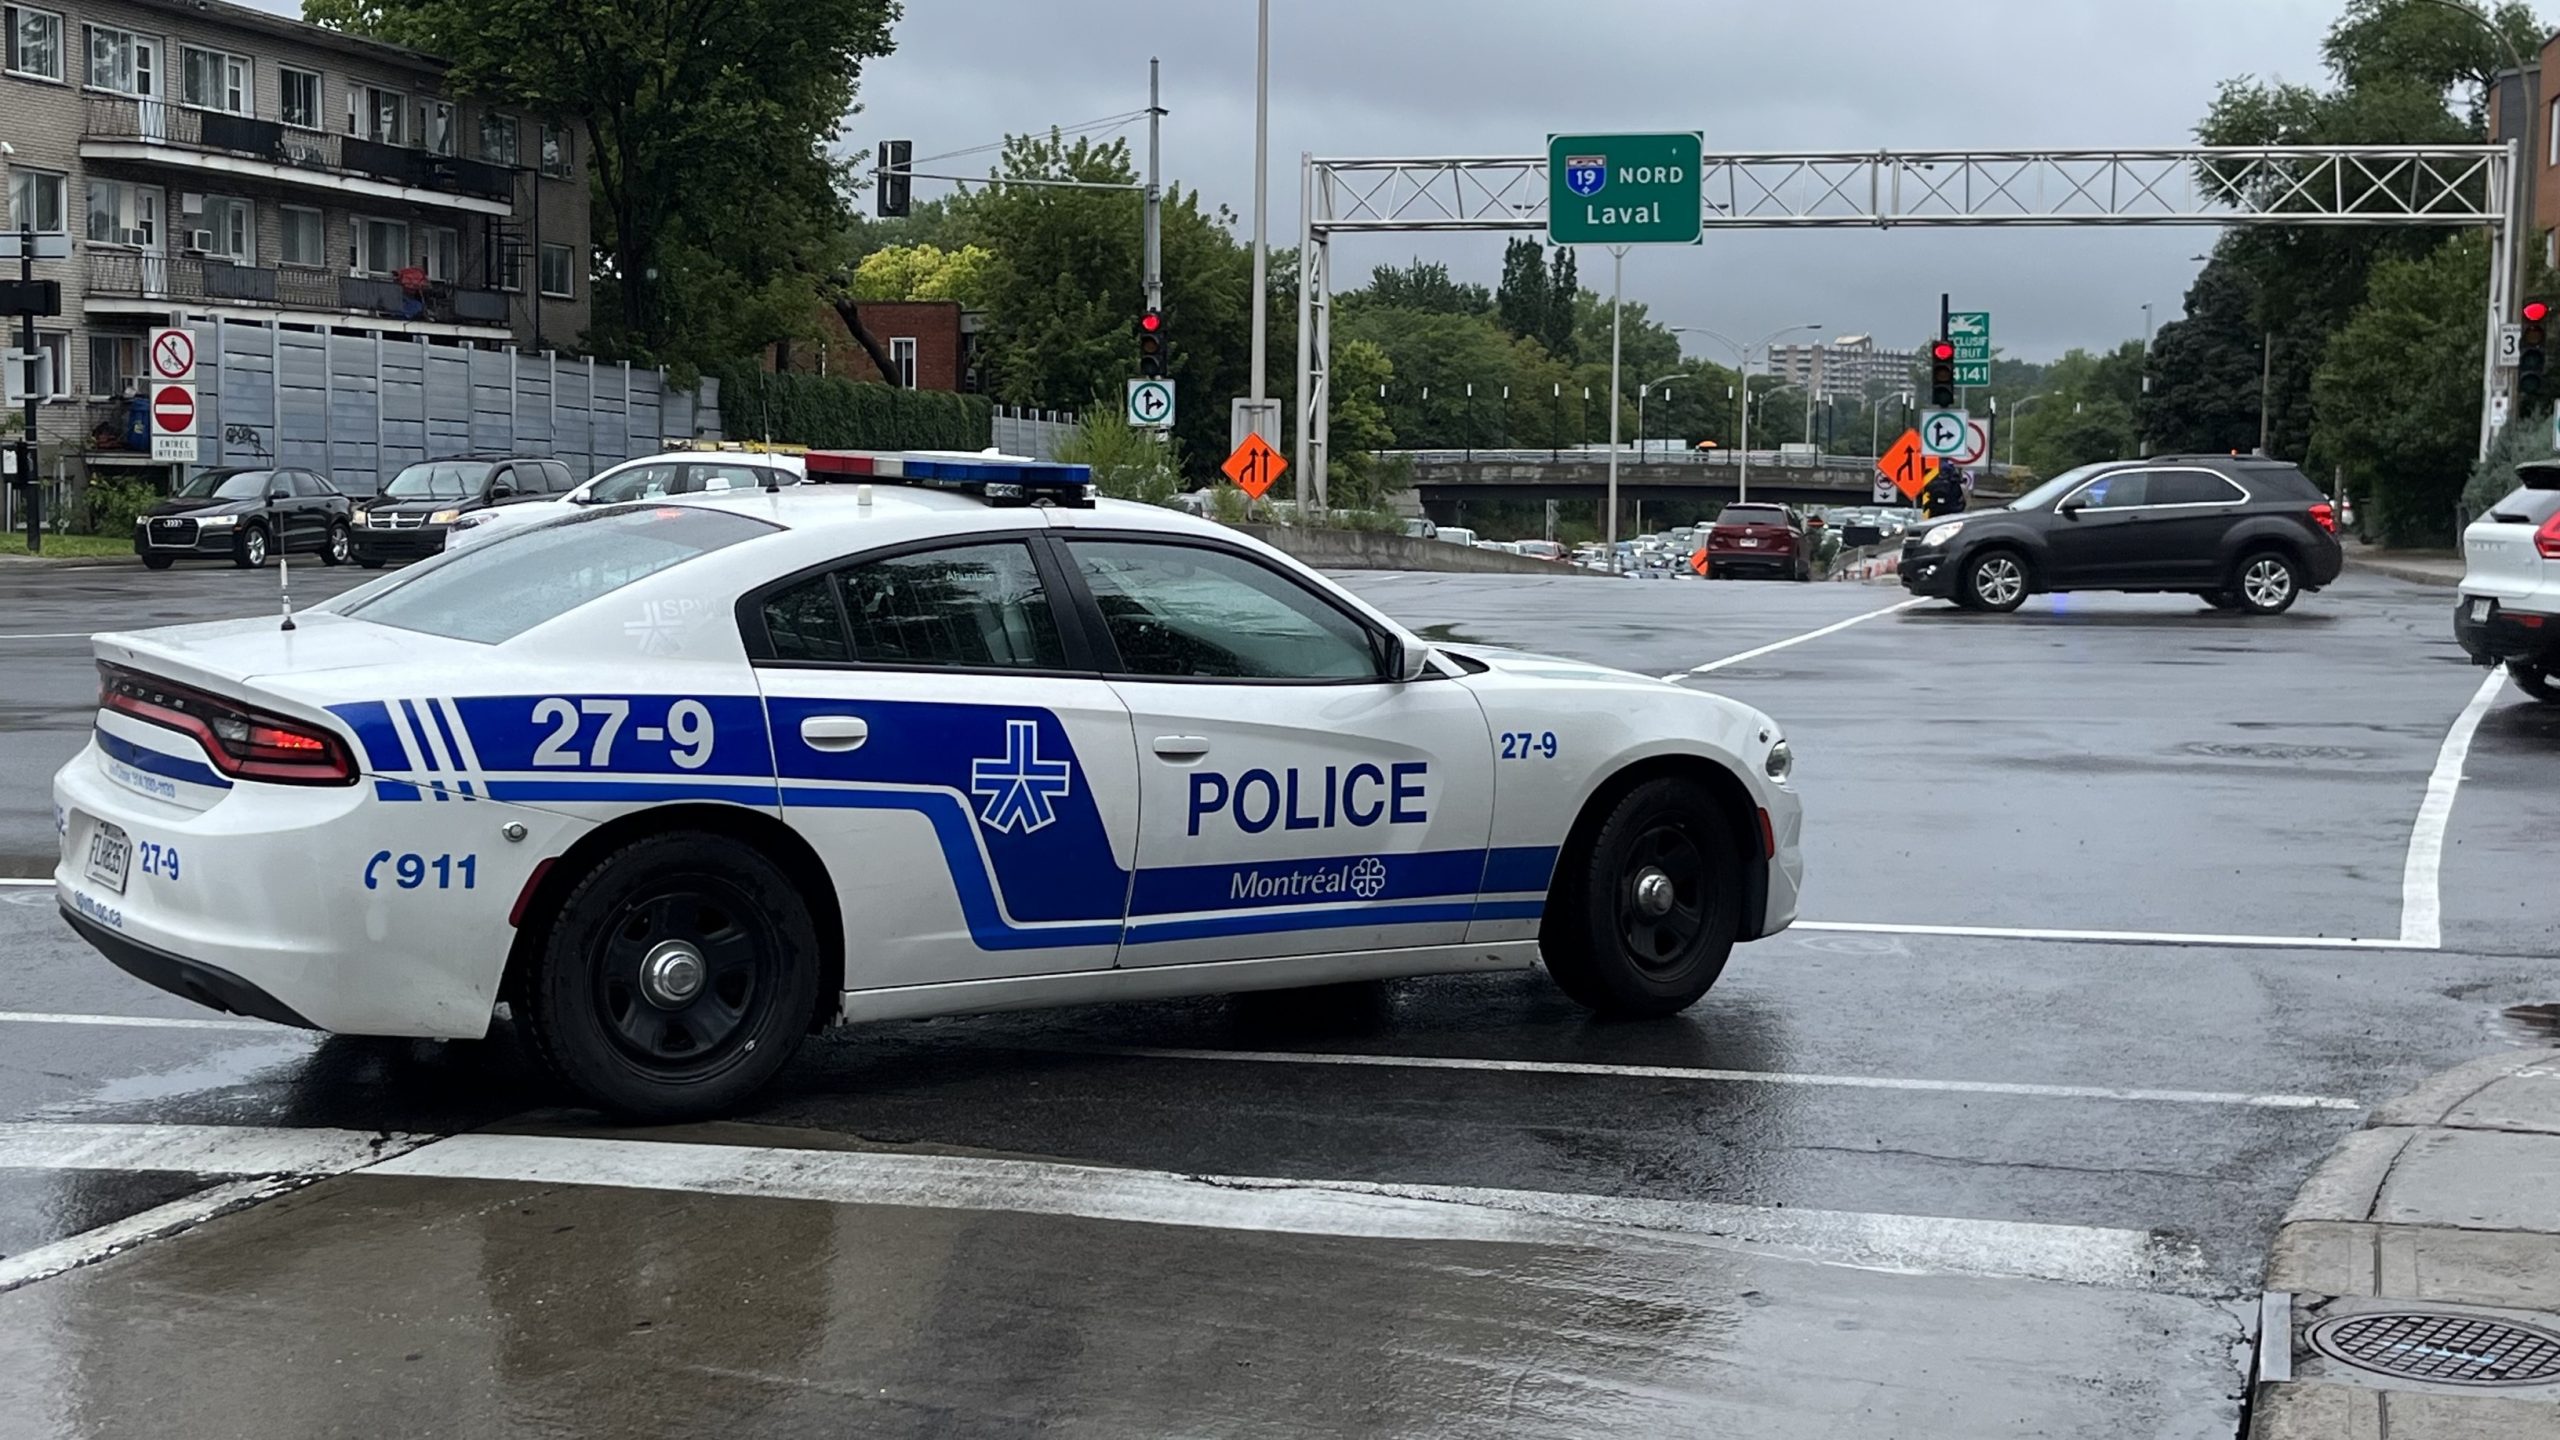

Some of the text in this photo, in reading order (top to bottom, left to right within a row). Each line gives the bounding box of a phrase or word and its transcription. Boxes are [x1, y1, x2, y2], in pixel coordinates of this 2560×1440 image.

[1576, 166, 1684, 186] 19 NORD
[1587, 201, 1661, 225] Laval
[1948, 336, 1988, 347] CLUSIF
[531, 697, 715, 769] 27-9
[1500, 731, 1558, 760] 27-9
[1187, 762, 1428, 837] POLICE
[140, 840, 180, 881] 27-9
[396, 853, 477, 890] 911
[1230, 865, 1350, 900] Montréal
